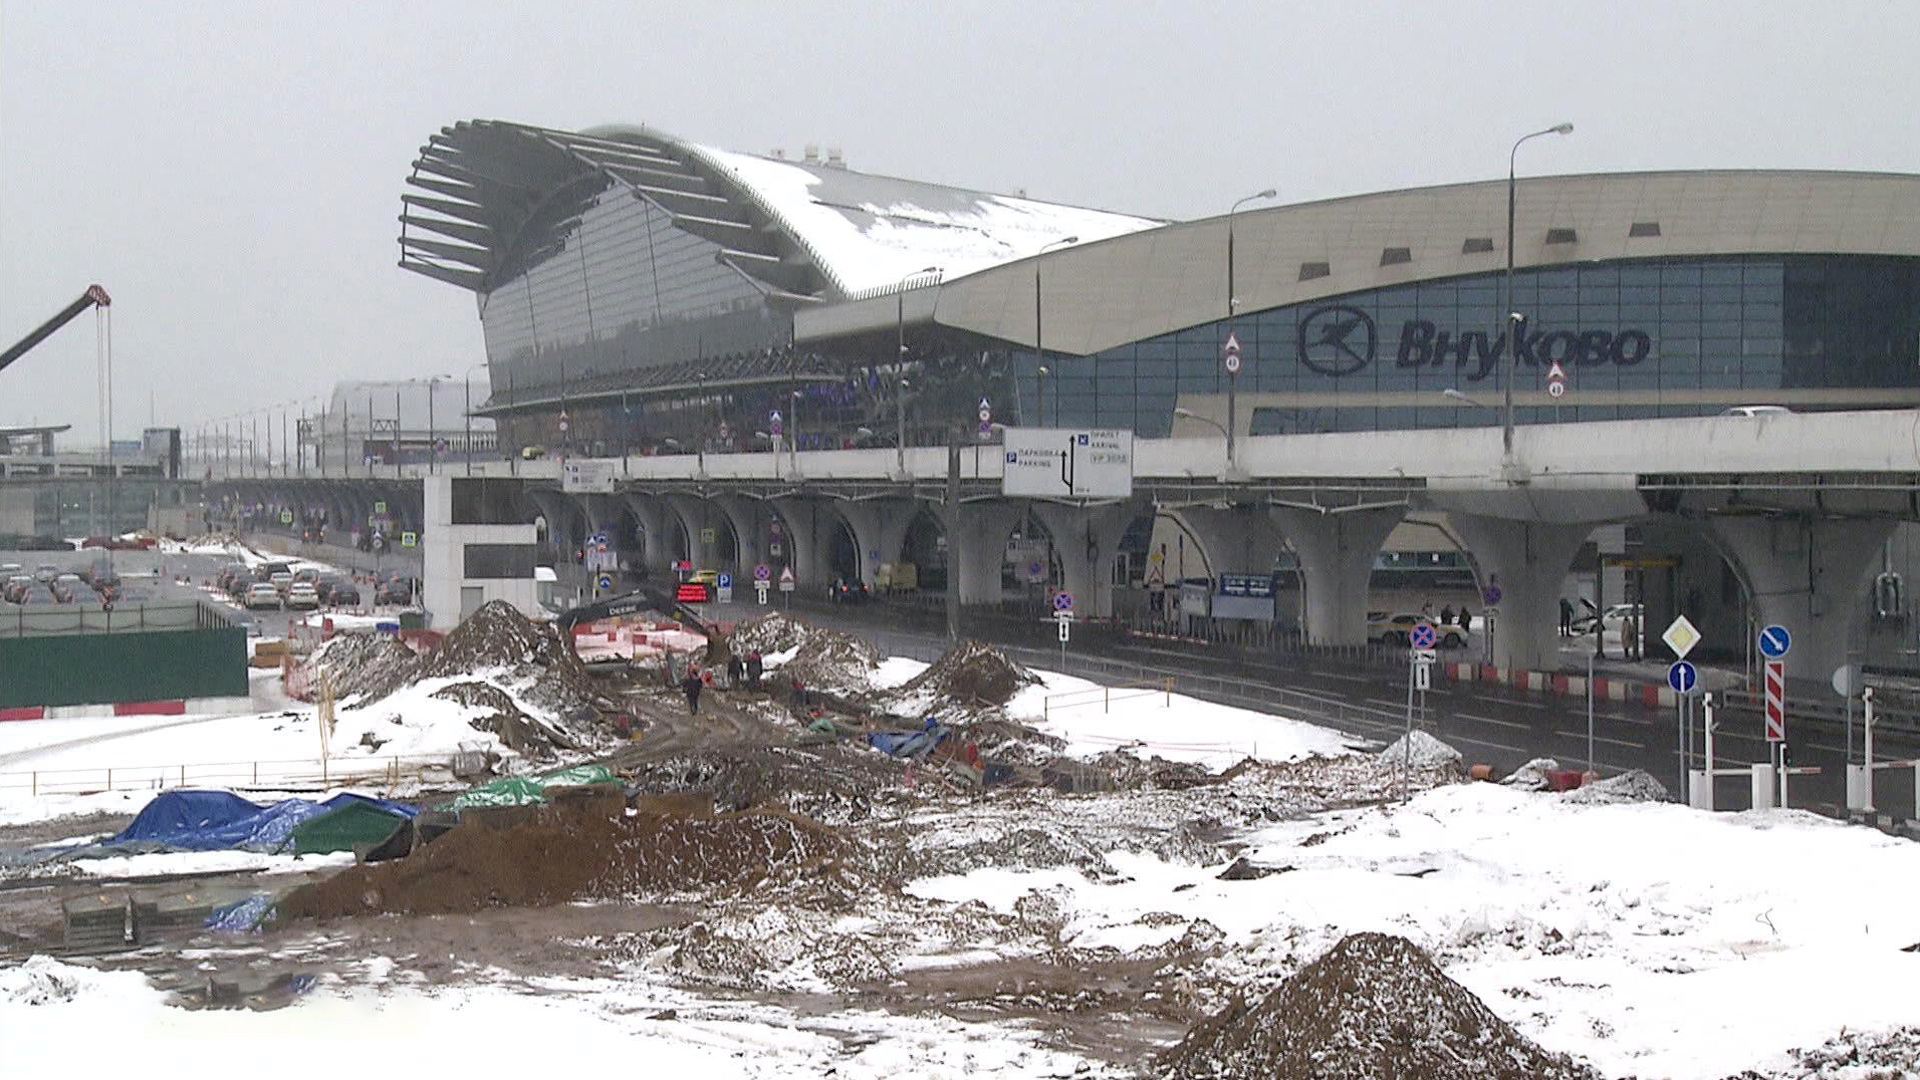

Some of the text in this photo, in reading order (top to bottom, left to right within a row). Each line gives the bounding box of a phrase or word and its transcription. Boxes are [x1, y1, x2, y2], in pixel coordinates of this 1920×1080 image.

[1396, 315, 1651, 381] Внуково
[1018, 449, 1060, 457] ПАРКОВКА
[1018, 460, 1051, 468] PARKING
